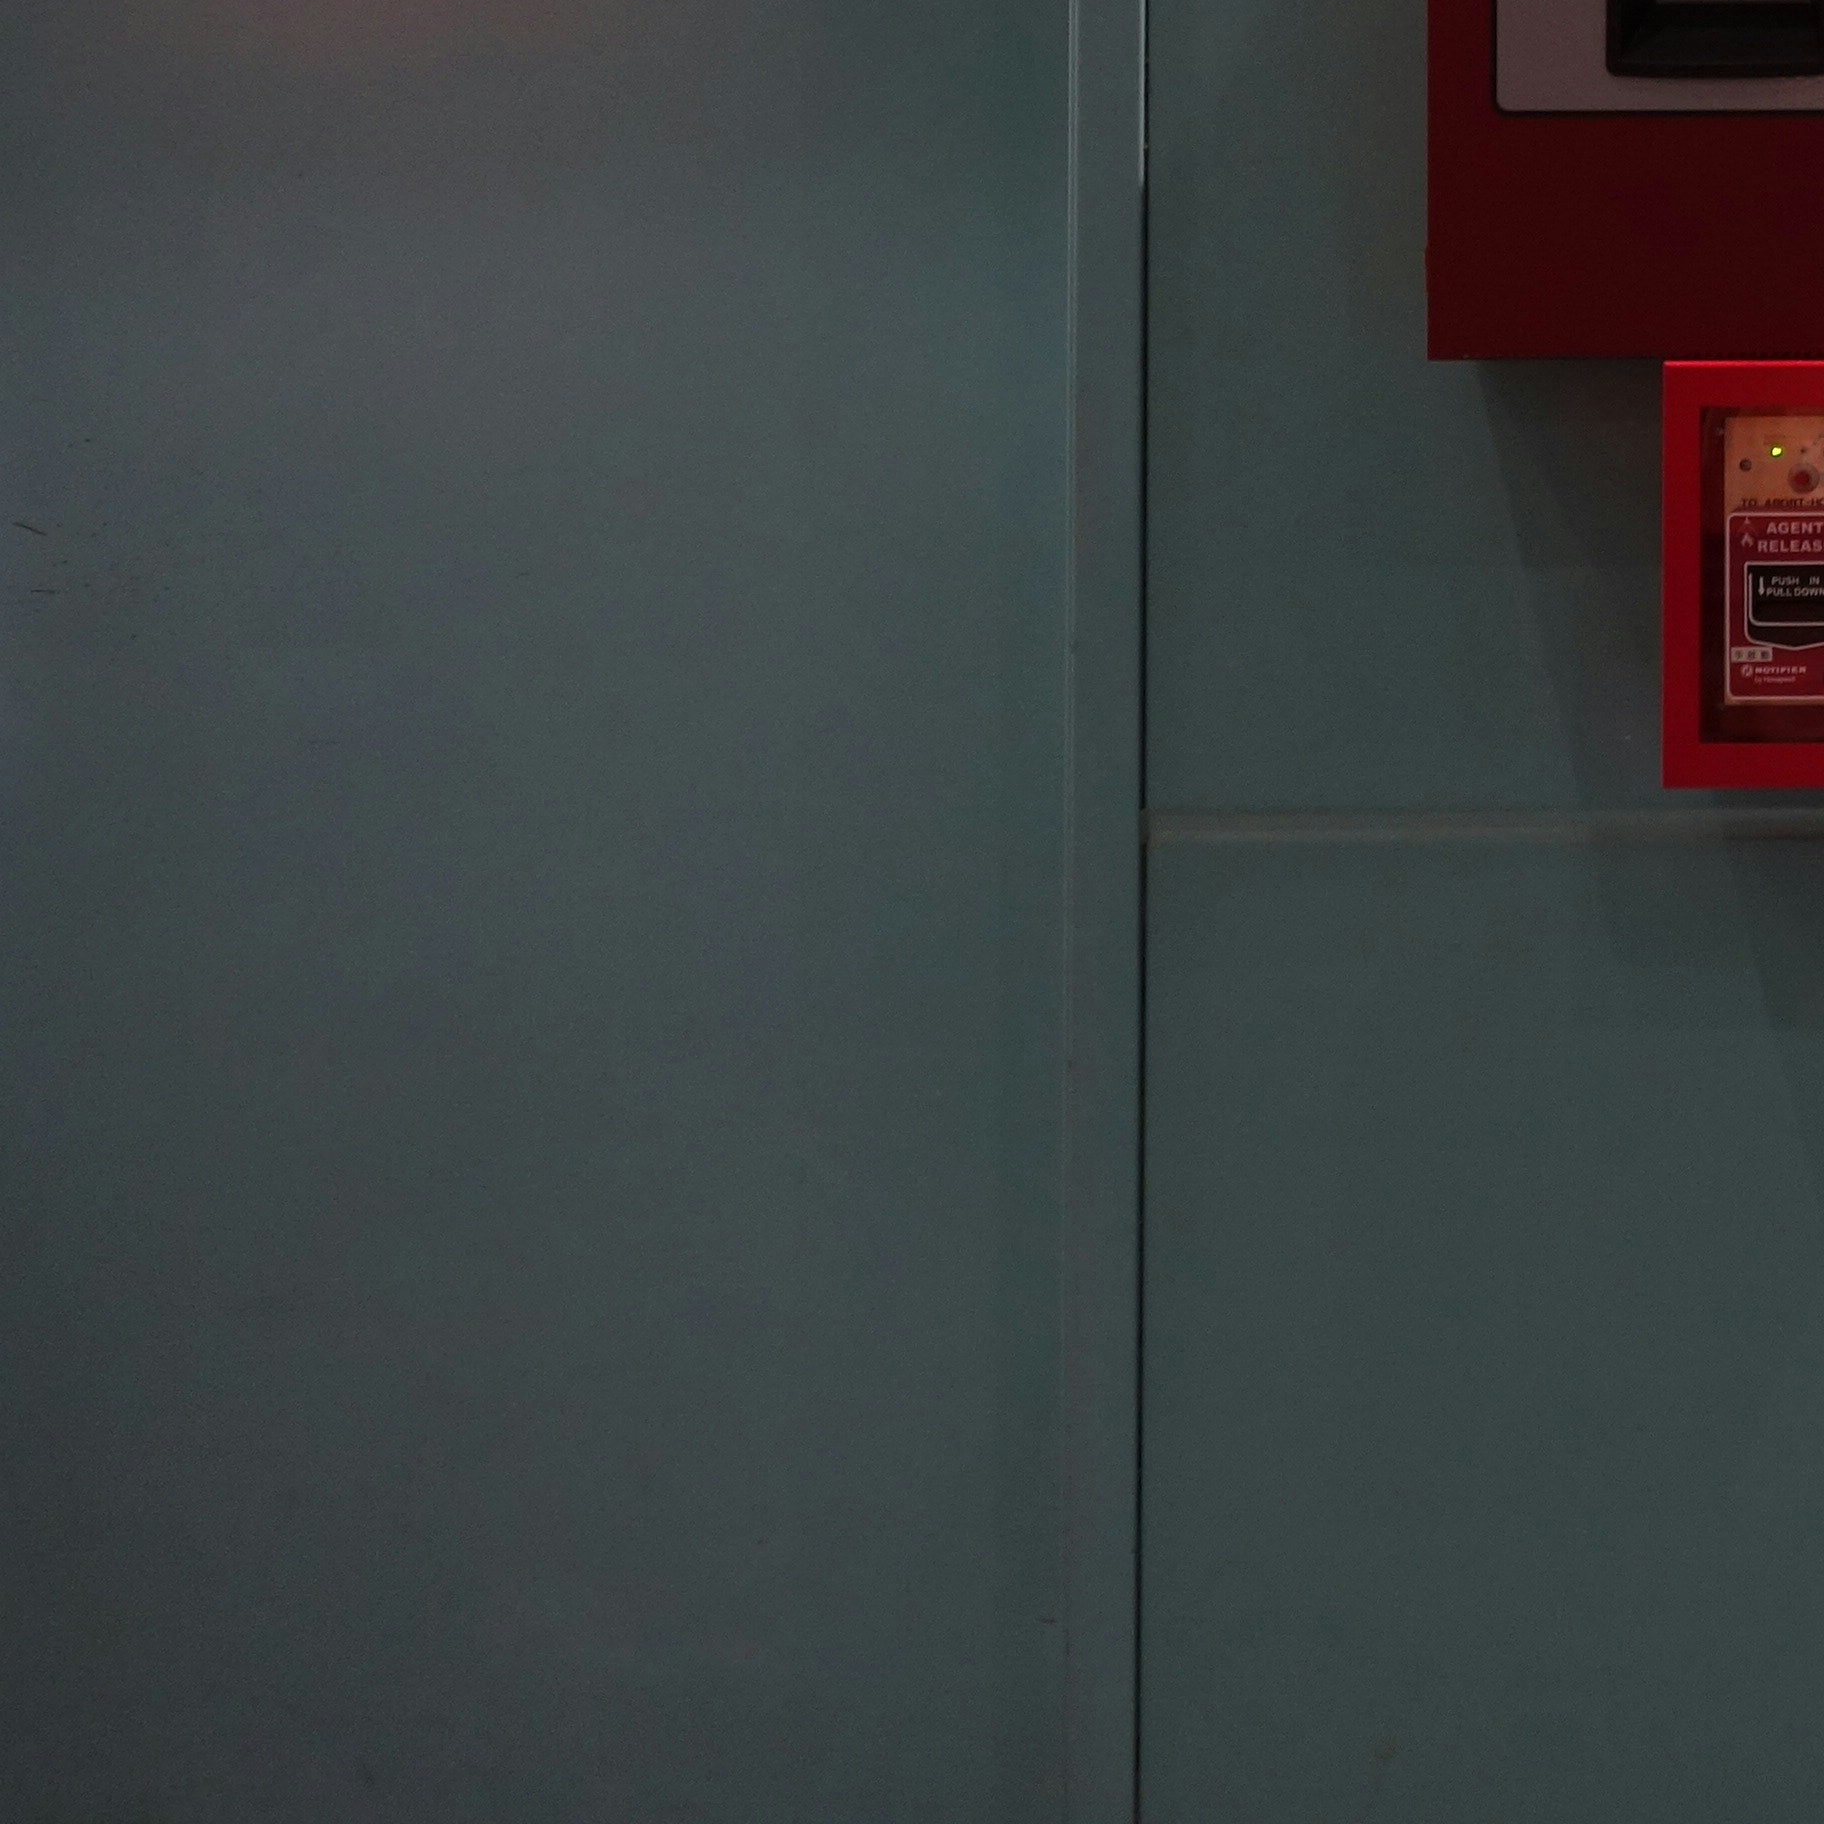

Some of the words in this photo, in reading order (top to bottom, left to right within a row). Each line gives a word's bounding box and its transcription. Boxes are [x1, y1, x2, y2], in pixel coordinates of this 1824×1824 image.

[1766, 521, 1824, 535] AGENT
[1771, 576, 1800, 586] PUSH
[1809, 576, 1820, 586] IN
[1766, 587, 1791, 597] PULL
